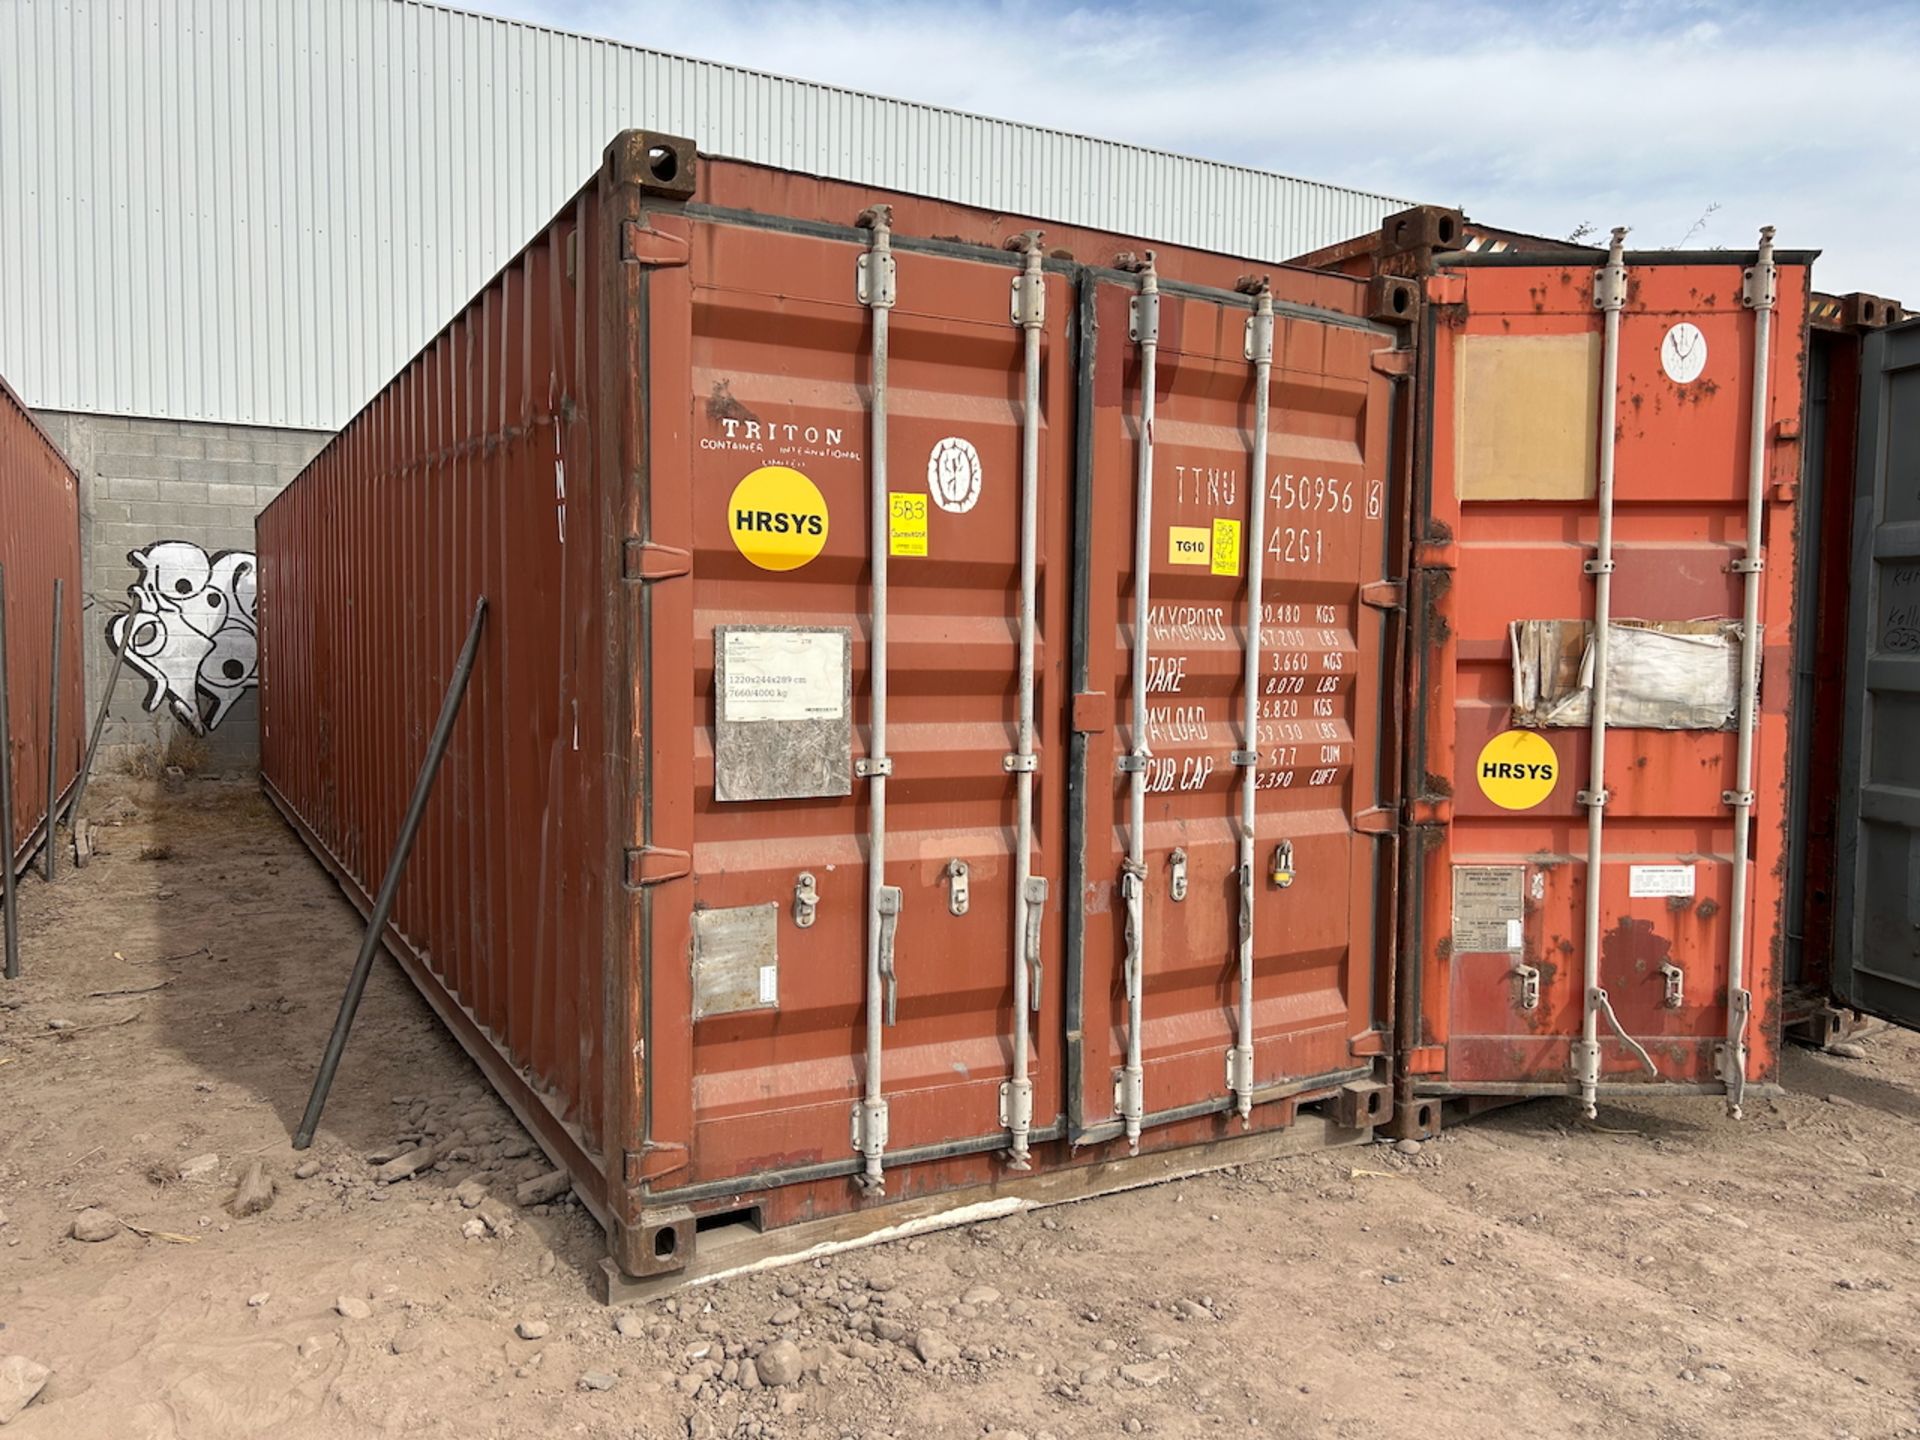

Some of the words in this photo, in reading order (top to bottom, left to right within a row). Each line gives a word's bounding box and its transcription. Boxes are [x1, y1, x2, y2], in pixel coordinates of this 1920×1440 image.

[722, 418, 842, 446] TRITON
[700, 438, 764, 453] CONTAINER
[1175, 466, 1236, 505] TTNU
[1269, 474, 1353, 513] 450956
[1368, 484, 1379, 516] 6
[892, 500, 925, 520] 583
[735, 509, 823, 536] HRSYS
[1176, 541, 1205, 553] TG10
[1267, 526, 1322, 563] 42G1
[1316, 605, 1335, 623] KGS
[1317, 630, 1339, 646] LBS
[1145, 657, 1187, 692] TARE
[1272, 653, 1308, 671] 3.660
[1323, 652, 1343, 670] KGS
[776, 689, 788, 698] kg
[1266, 677, 1304, 694] 8.070
[1316, 676, 1340, 693] LBS
[1313, 698, 1333, 717] KGS
[1315, 722, 1338, 739] LBS
[1180, 756, 1214, 790] CAP
[1321, 745, 1340, 763] CUM
[1482, 762, 1554, 781] HRSYS
[1255, 771, 1294, 789] 2.390
